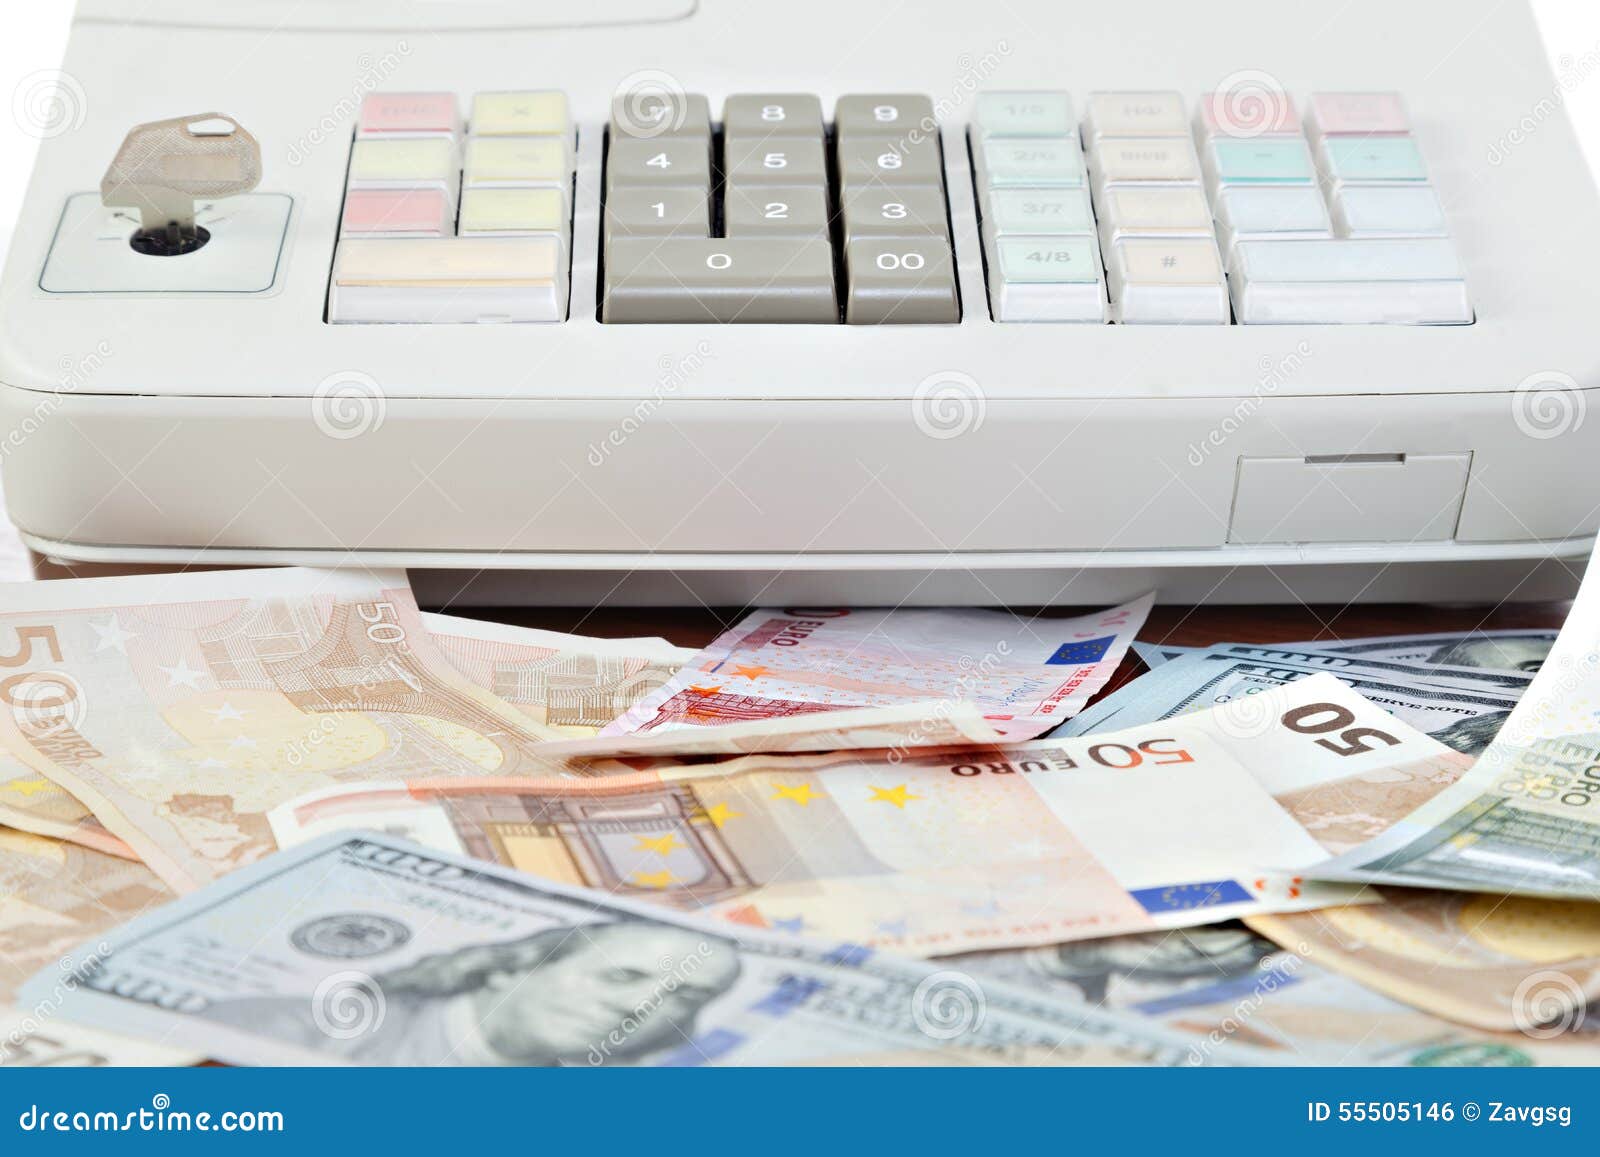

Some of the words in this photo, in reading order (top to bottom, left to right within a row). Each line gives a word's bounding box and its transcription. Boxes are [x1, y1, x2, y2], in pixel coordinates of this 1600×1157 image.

[649, 106, 671, 121] 7
[761, 105, 785, 121] 8
[873, 105, 898, 121] 9
[646, 153, 671, 168] 4
[763, 153, 787, 168] 5
[877, 153, 902, 169] 6
[651, 203, 665, 217] 1
[764, 203, 789, 218] 2
[881, 203, 907, 219] 3
[1022, 202, 1065, 215] 3/7
[706, 254, 732, 269] 0
[876, 254, 925, 270] 00
[1026, 251, 1072, 263] 4/8
[357, 602, 406, 643] 50
[771, 620, 825, 646] EURO
[0, 625, 77, 708] 50
[1424, 705, 1478, 716] NOTE
[1281, 702, 1402, 756] 50
[1088, 738, 1195, 769] 50
[951, 759, 1079, 777] EURO
[1561, 750, 1600, 807] URO
